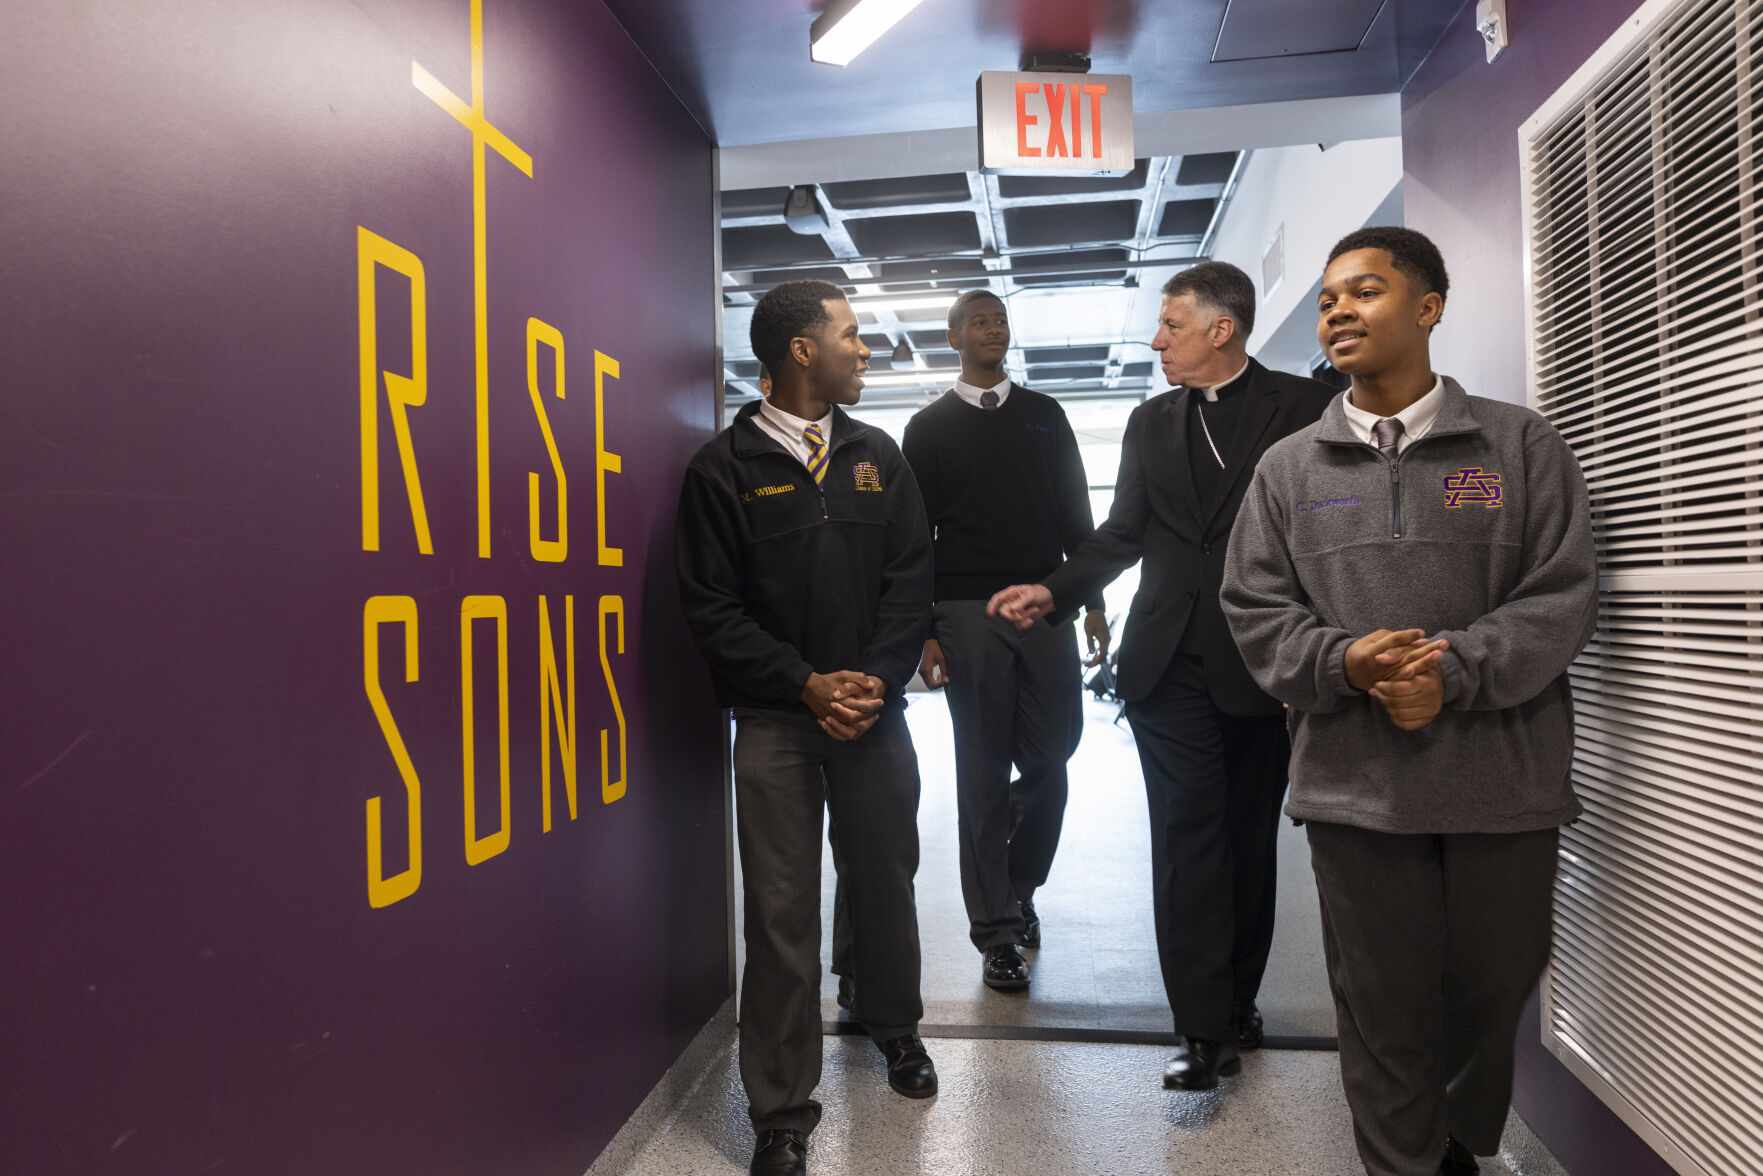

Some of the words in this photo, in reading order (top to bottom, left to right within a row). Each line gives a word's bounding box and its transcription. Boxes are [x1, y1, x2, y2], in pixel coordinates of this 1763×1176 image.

[1015, 82, 1107, 159] EXIT
[357, 0, 624, 567] RISE
[754, 483, 796, 497] Williams
[363, 595, 627, 908] SONS
